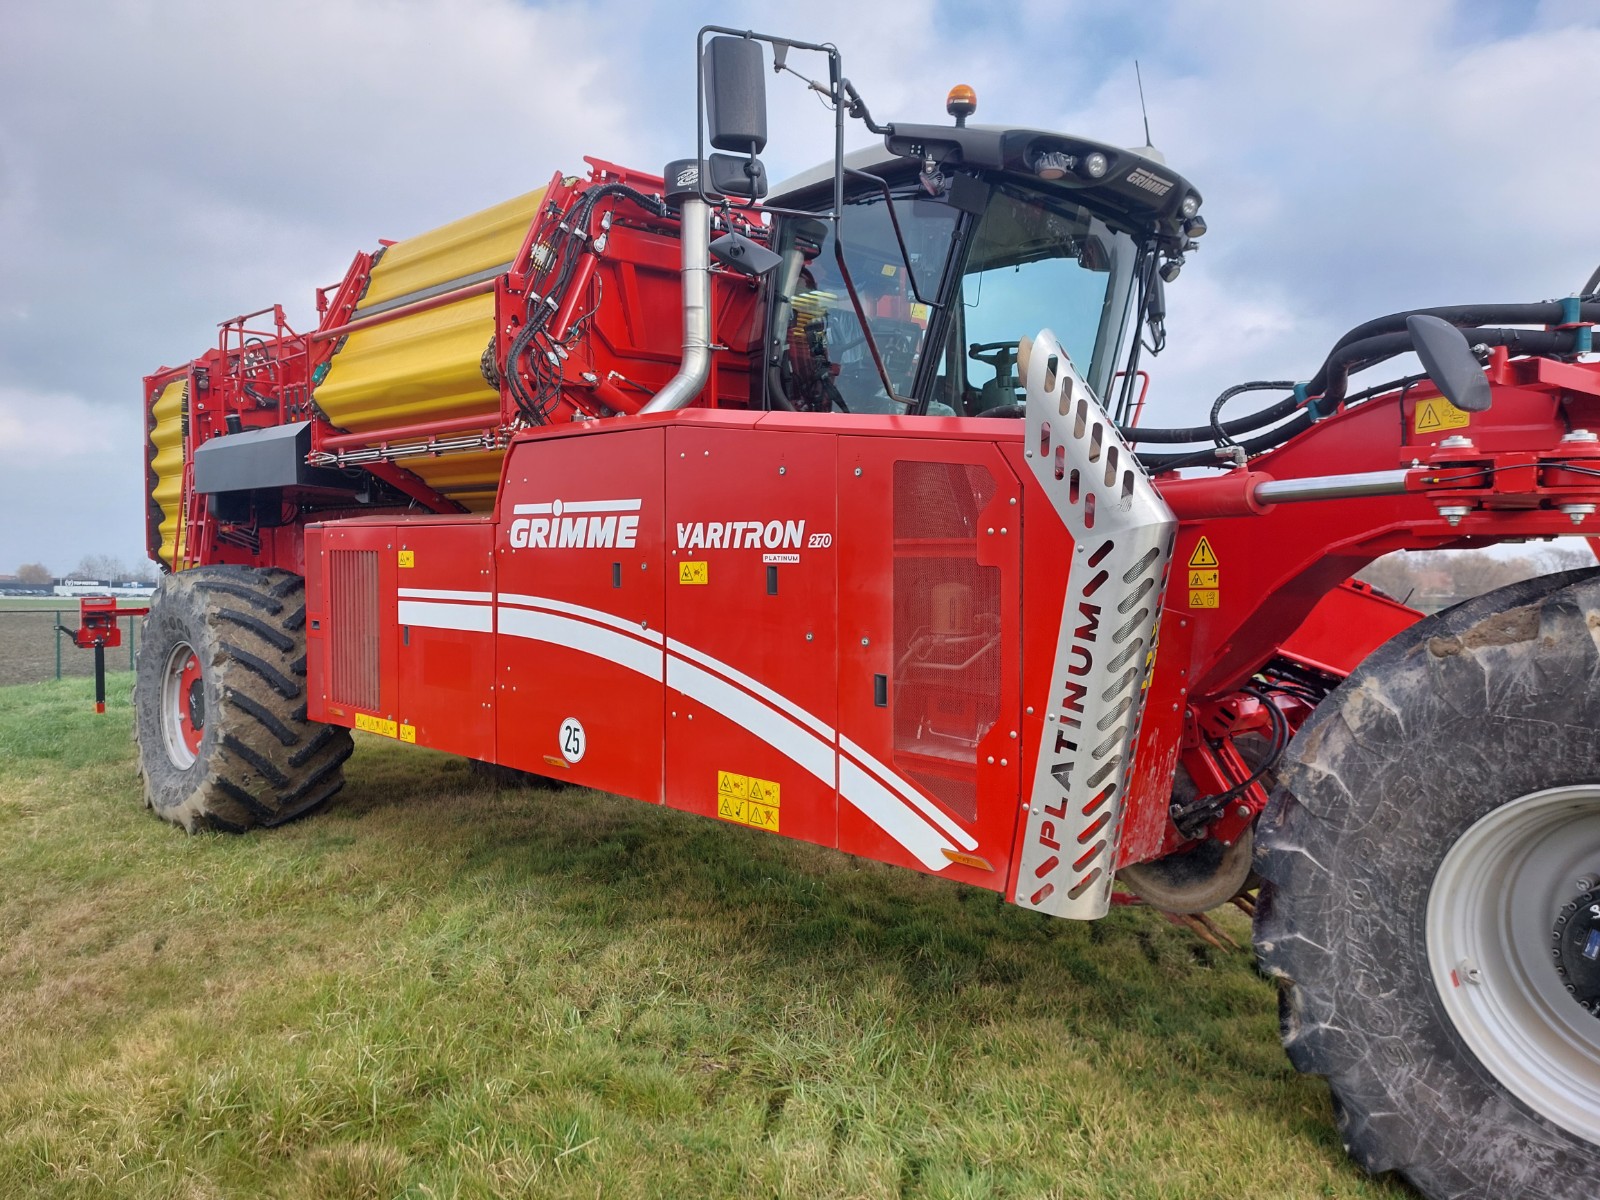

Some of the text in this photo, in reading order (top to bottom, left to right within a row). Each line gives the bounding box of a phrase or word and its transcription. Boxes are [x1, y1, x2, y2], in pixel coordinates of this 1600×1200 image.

[1126, 170, 1172, 196] GRIMME
[509, 500, 641, 549] GRIMME
[677, 520, 832, 549] VARITRON 270
[564, 725, 580, 755] 25
[1039, 601, 1101, 852] PLATINUM
